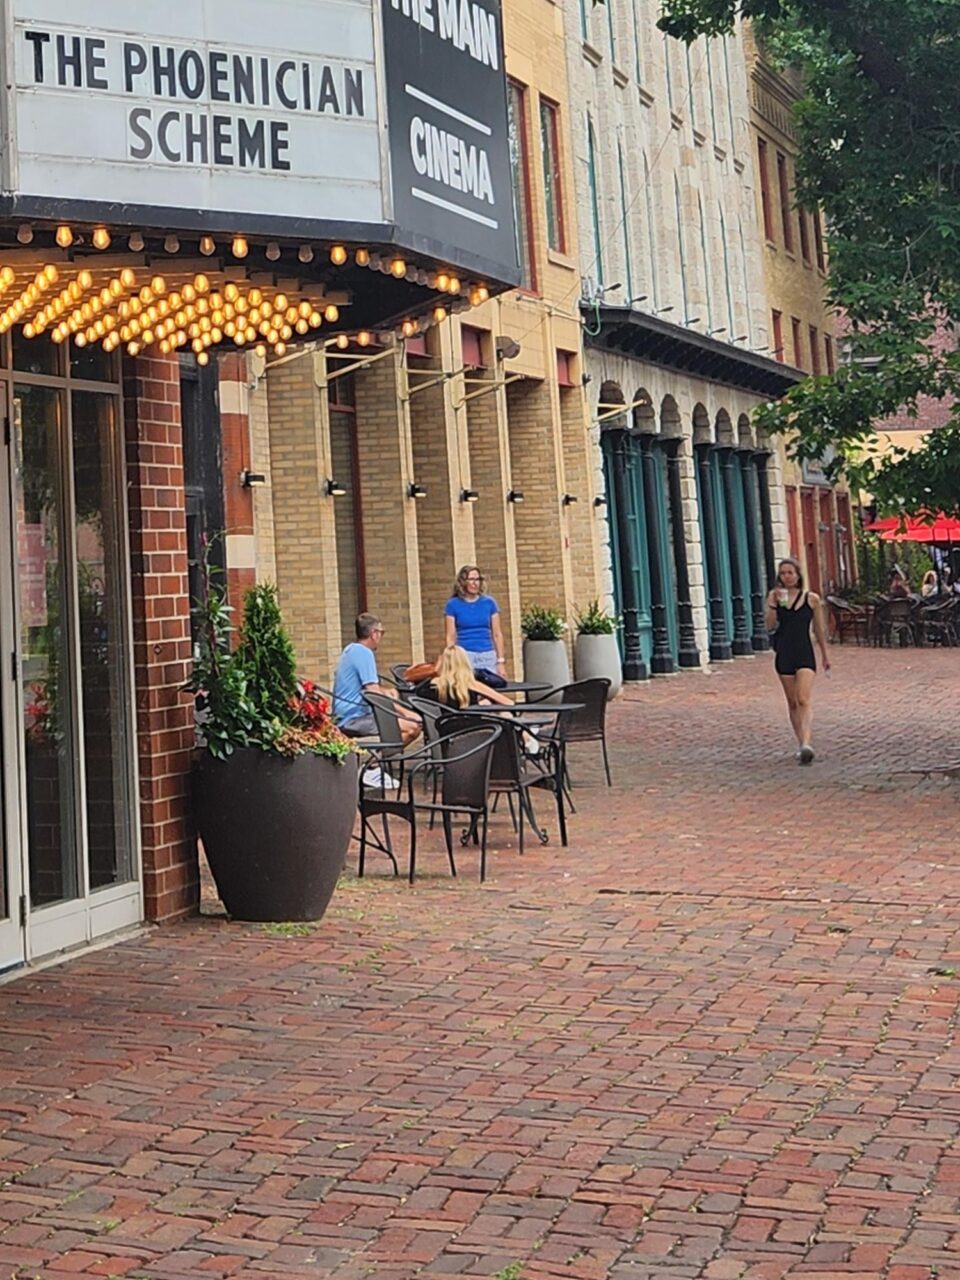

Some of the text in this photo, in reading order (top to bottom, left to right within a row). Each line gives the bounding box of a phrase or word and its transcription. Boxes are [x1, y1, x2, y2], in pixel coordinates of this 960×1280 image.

[24, 30, 365, 117] THE PHOENICIAN
[129, 107, 291, 171] SCHEME
[410, 116, 495, 205] CINEMA
